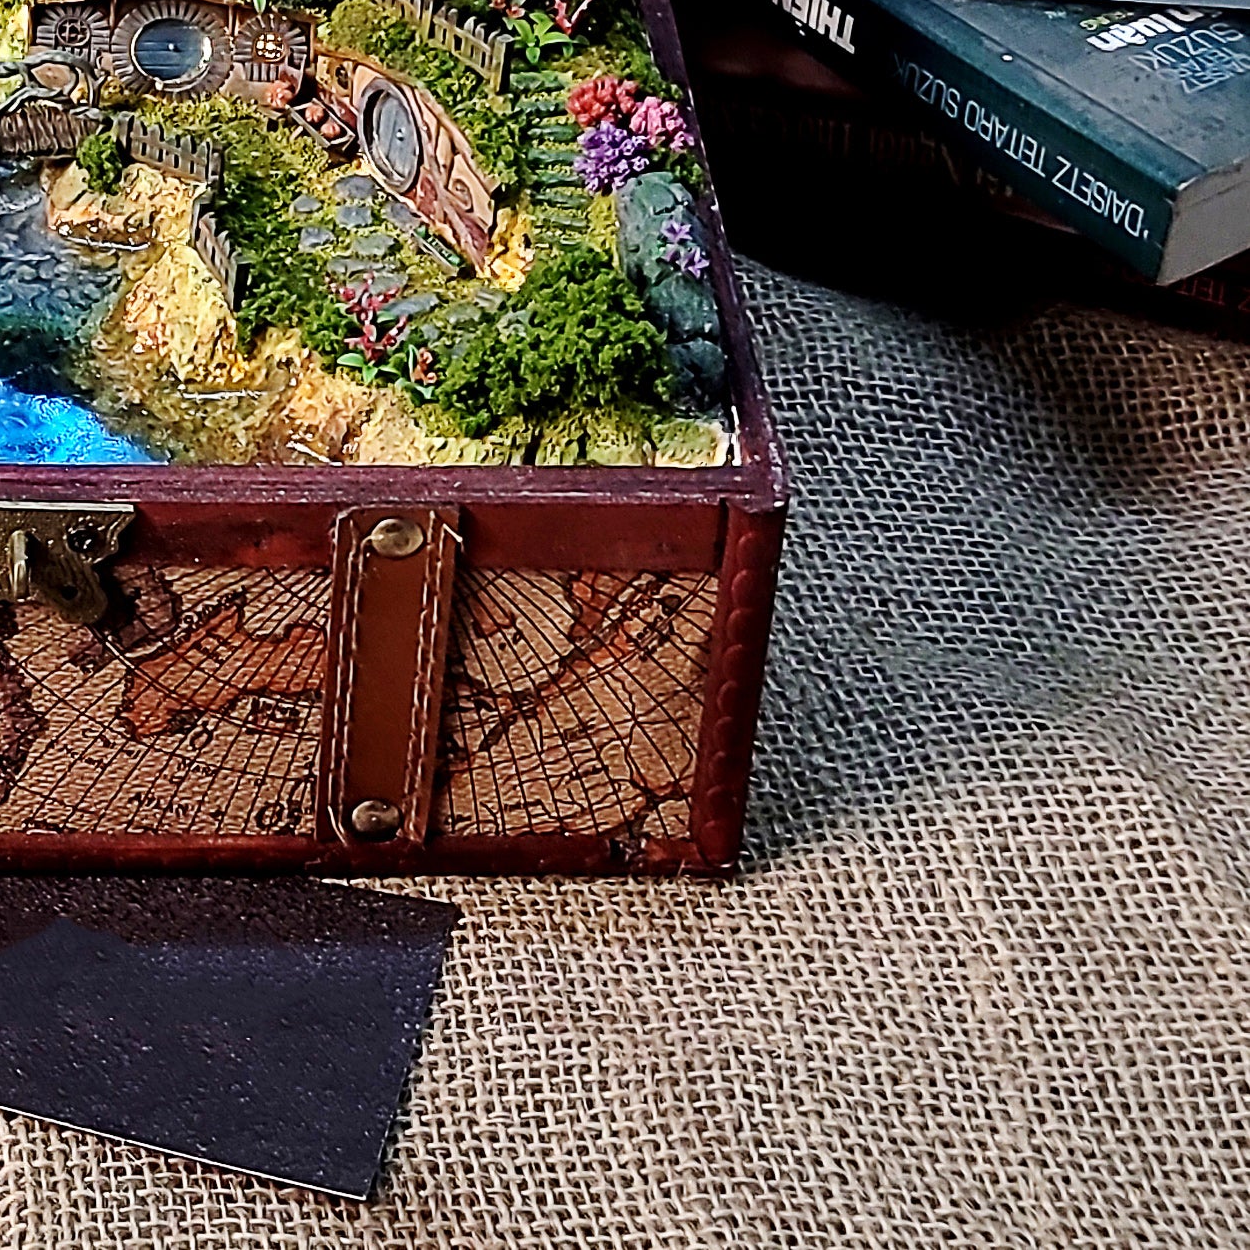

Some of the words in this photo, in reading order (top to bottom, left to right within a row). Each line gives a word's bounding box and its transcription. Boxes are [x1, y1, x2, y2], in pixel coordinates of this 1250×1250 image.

[890, 52, 961, 118] SUZUK
[963, 99, 1046, 178] TEITARO
[1051, 154, 1144, 238] DAISETZ
